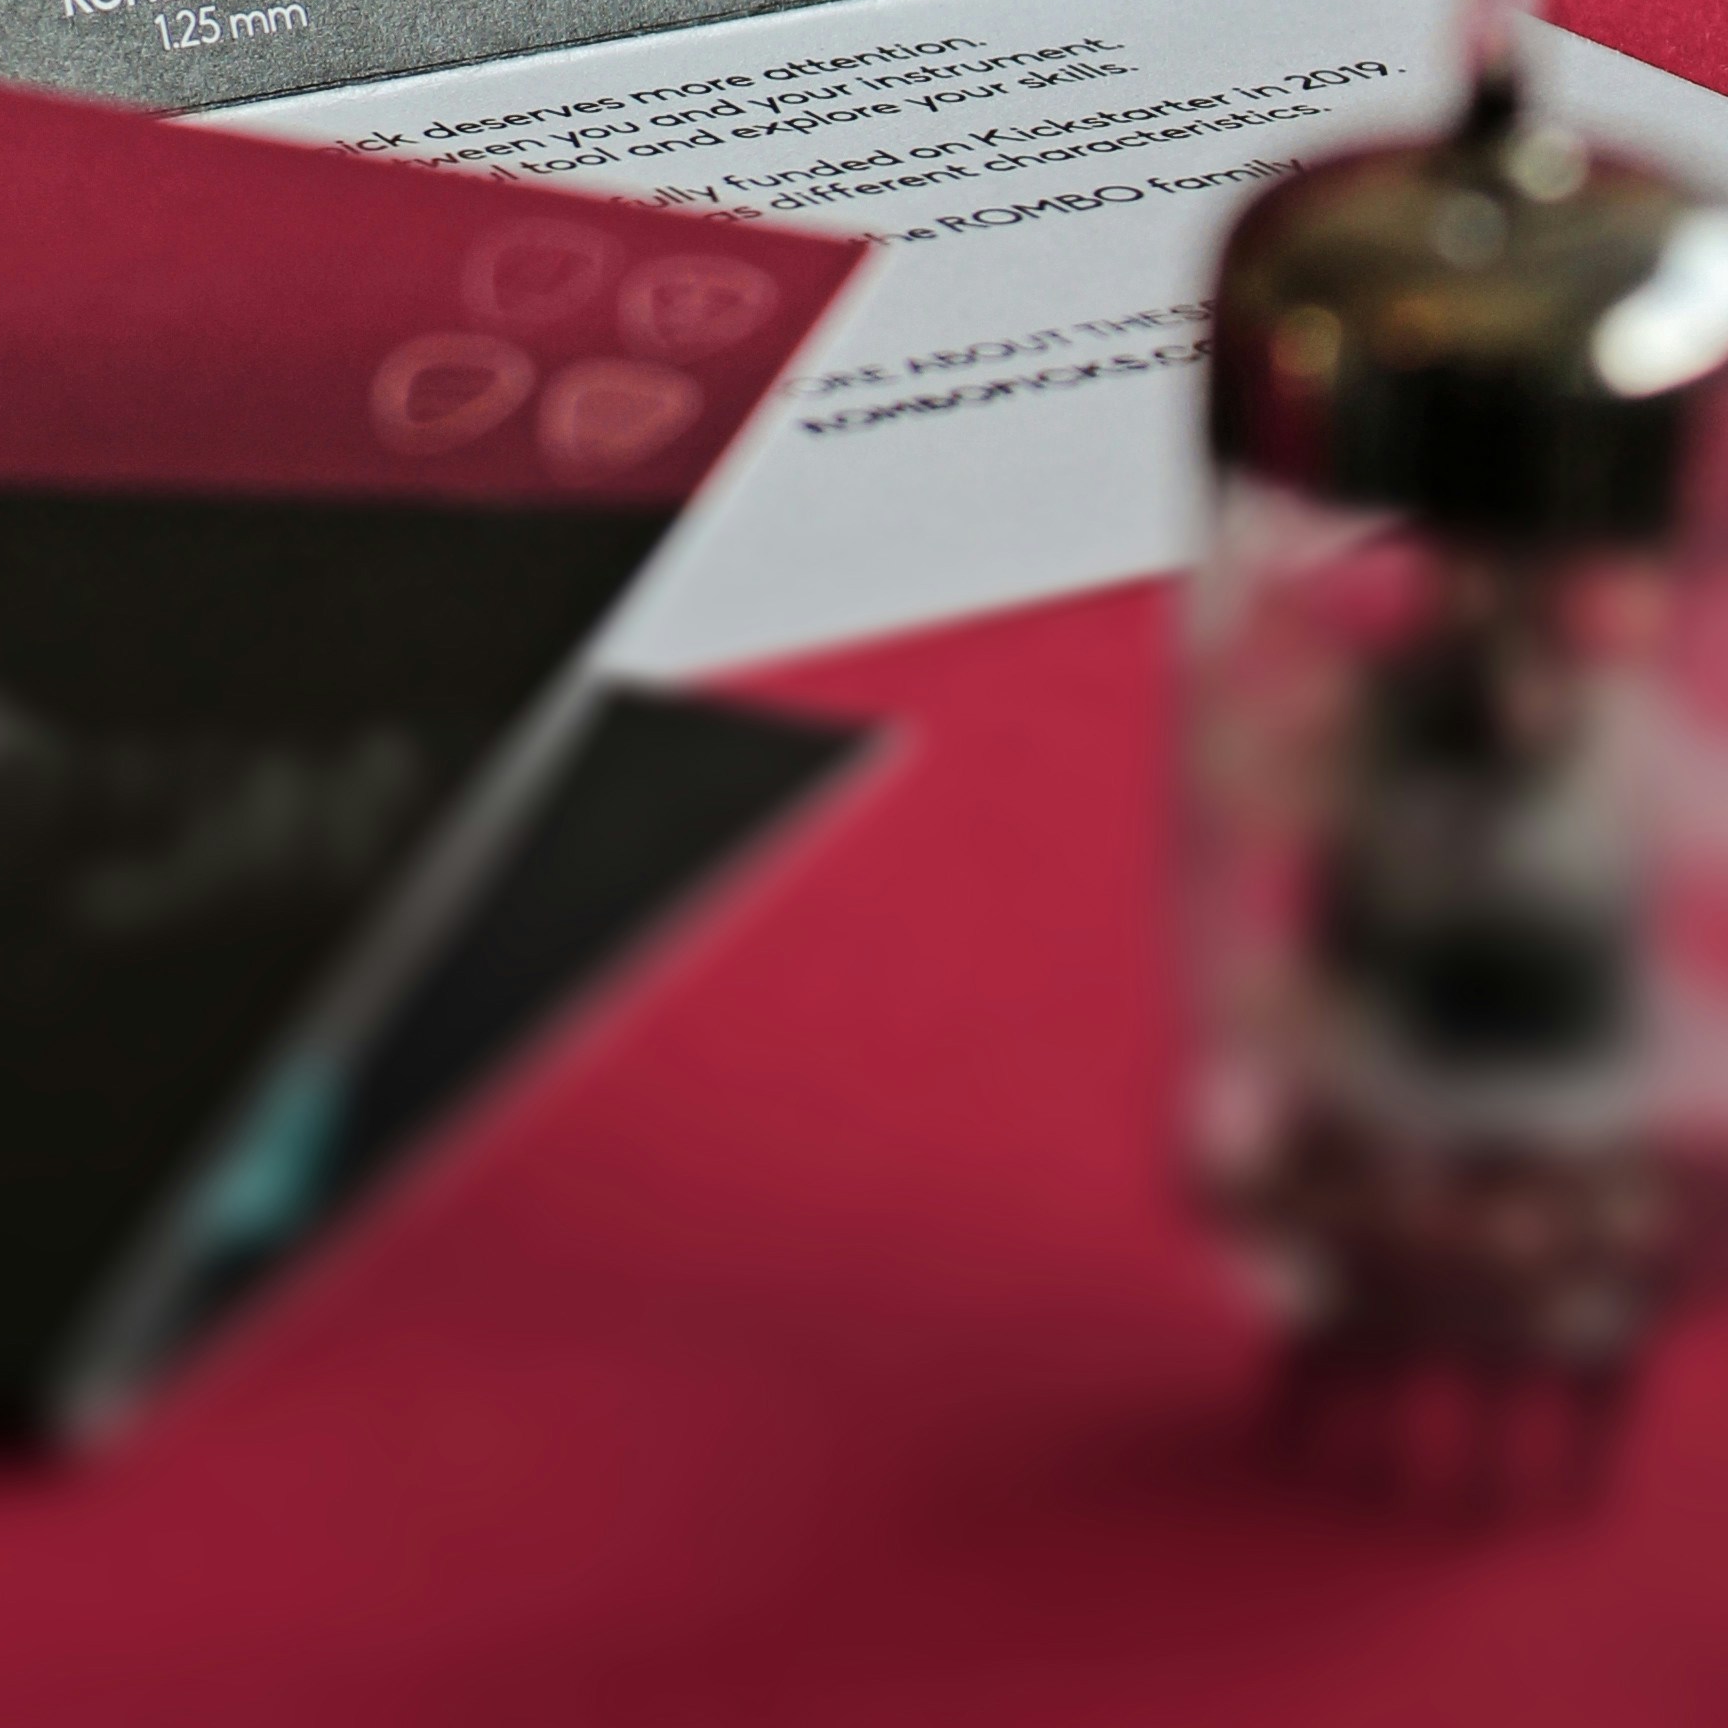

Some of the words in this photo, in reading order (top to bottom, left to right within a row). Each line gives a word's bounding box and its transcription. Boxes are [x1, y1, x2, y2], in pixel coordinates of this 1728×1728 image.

[154, 7, 221, 52] 1.25
[229, 0, 308, 40] mm
[423, 92, 626, 140] deserves
[629, 74, 755, 106] more
[763, 36, 988, 83] attention.
[520, 146, 621, 176] tool
[627, 128, 726, 157] and
[730, 100, 902, 135] explore
[904, 80, 1009, 113] your
[1017, 61, 1139, 90] skills.
[550, 120, 640, 149] you
[649, 98, 744, 128] and
[749, 81, 852, 114] your
[859, 37, 1125, 91] instrument.
[723, 149, 903, 191] funded
[909, 141, 972, 161] on
[970, 93, 1231, 148] Kickstarter
[1232, 84, 1290, 101] in
[771, 163, 981, 211] different
[983, 102, 1333, 173] characteristics.
[935, 184, 1144, 234] ROMBO
